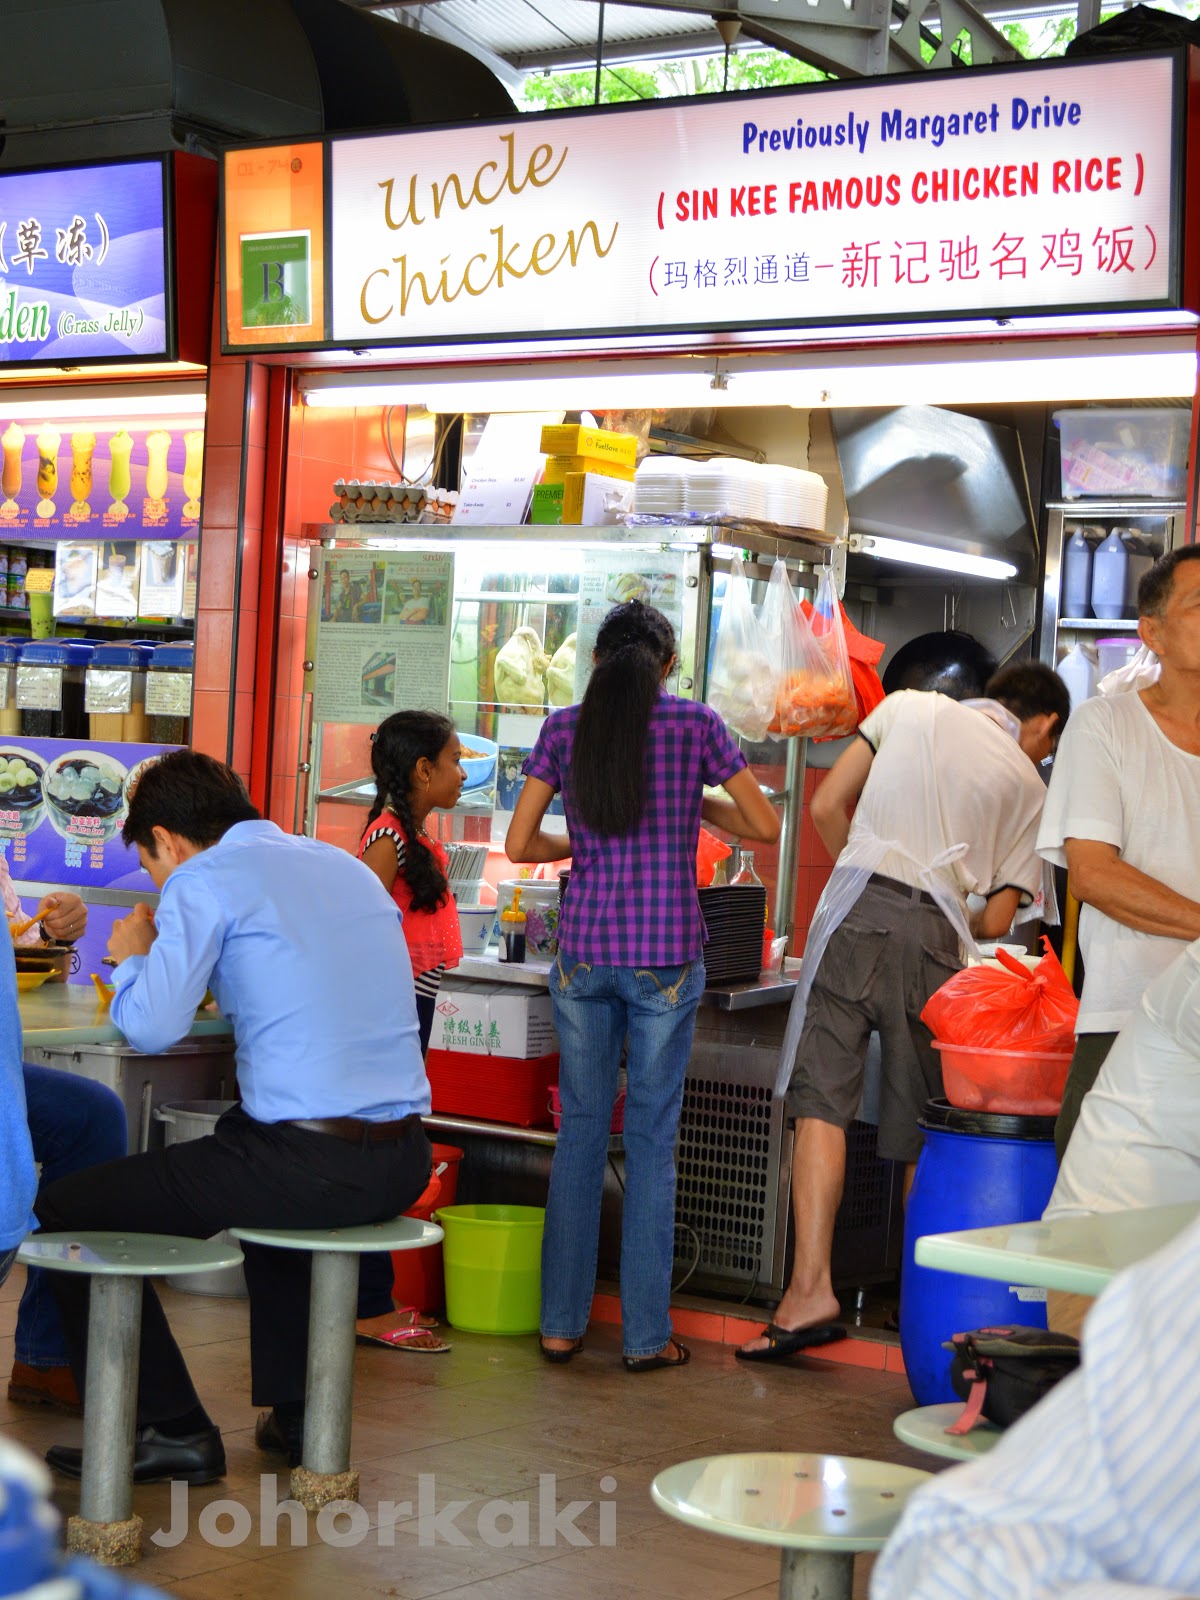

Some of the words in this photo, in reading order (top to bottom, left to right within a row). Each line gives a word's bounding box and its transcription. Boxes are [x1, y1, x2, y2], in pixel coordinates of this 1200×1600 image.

[742, 111, 870, 155] Previously
[880, 102, 1000, 148] Margaret
[1011, 94, 1082, 131] Drive
[377, 130, 569, 231] Uncle
[730, 184, 778, 218] KEE
[789, 173, 901, 214] FAMOUS
[911, 161, 1039, 205] CHICKEN
[261, 262, 286, 303] B
[359, 223, 619, 325] Chicken
[58, 312, 100, 337] (Grass
[103, 307, 144, 338] Jelly)
[595, 441, 619, 453] FuelSave
[442, 1034, 468, 1046] FRESH
[469, 1037, 501, 1049] GINGER
[443, 1016, 501, 1039] 特级生姜
